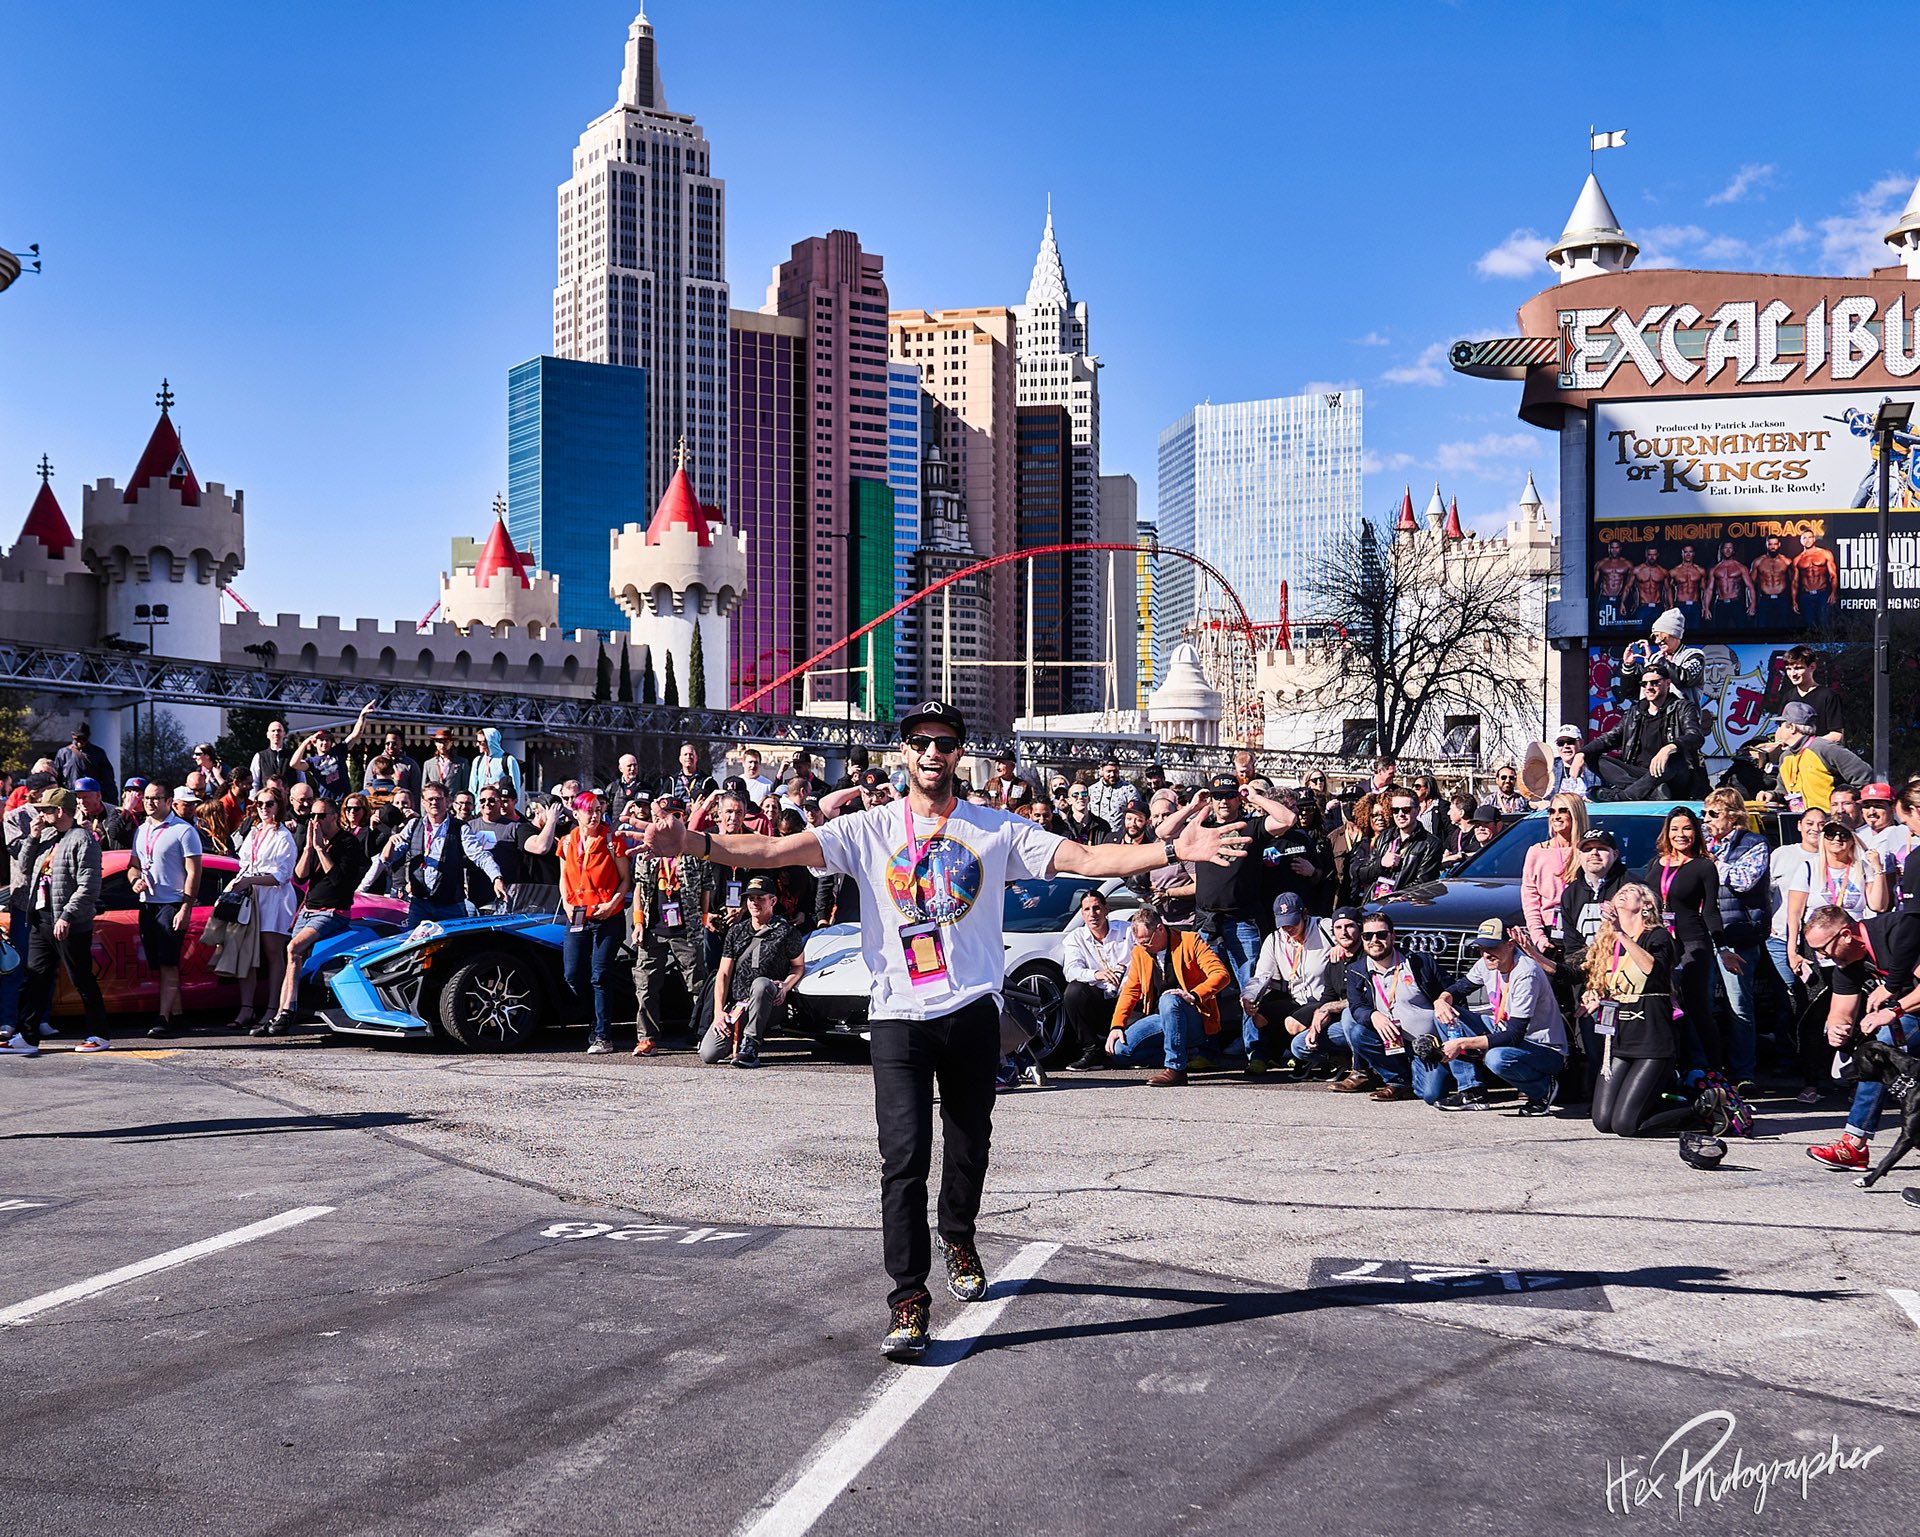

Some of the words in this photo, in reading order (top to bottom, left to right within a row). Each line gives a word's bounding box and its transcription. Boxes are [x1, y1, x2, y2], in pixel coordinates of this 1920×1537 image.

[1570, 291, 1920, 390] EXCALIBU
[1656, 423, 1698, 432] Produced
[1701, 422, 1712, 431] by
[1715, 421, 1747, 430] Patrick
[1749, 420, 1785, 428] Jackson
[1608, 430, 1831, 465] TOURNAMENT
[1626, 464, 1660, 481] OF
[1659, 459, 1811, 493] KINGS
[1710, 486, 1732, 495] Eat.
[1734, 484, 1768, 495] Drink.
[1771, 484, 1784, 493] Be
[1787, 482, 1825, 494] Rowdy!
[1665, 523, 1723, 540] NIGHT
[1728, 519, 1825, 537] OUTBACK
[1836, 537, 1920, 568] THUND
[1840, 568, 1878, 590] DOW
[1841, 598, 1902, 610] PERFORNG
[938, 902, 968, 922] MOON
[1618, 1010, 1646, 1020] EX
